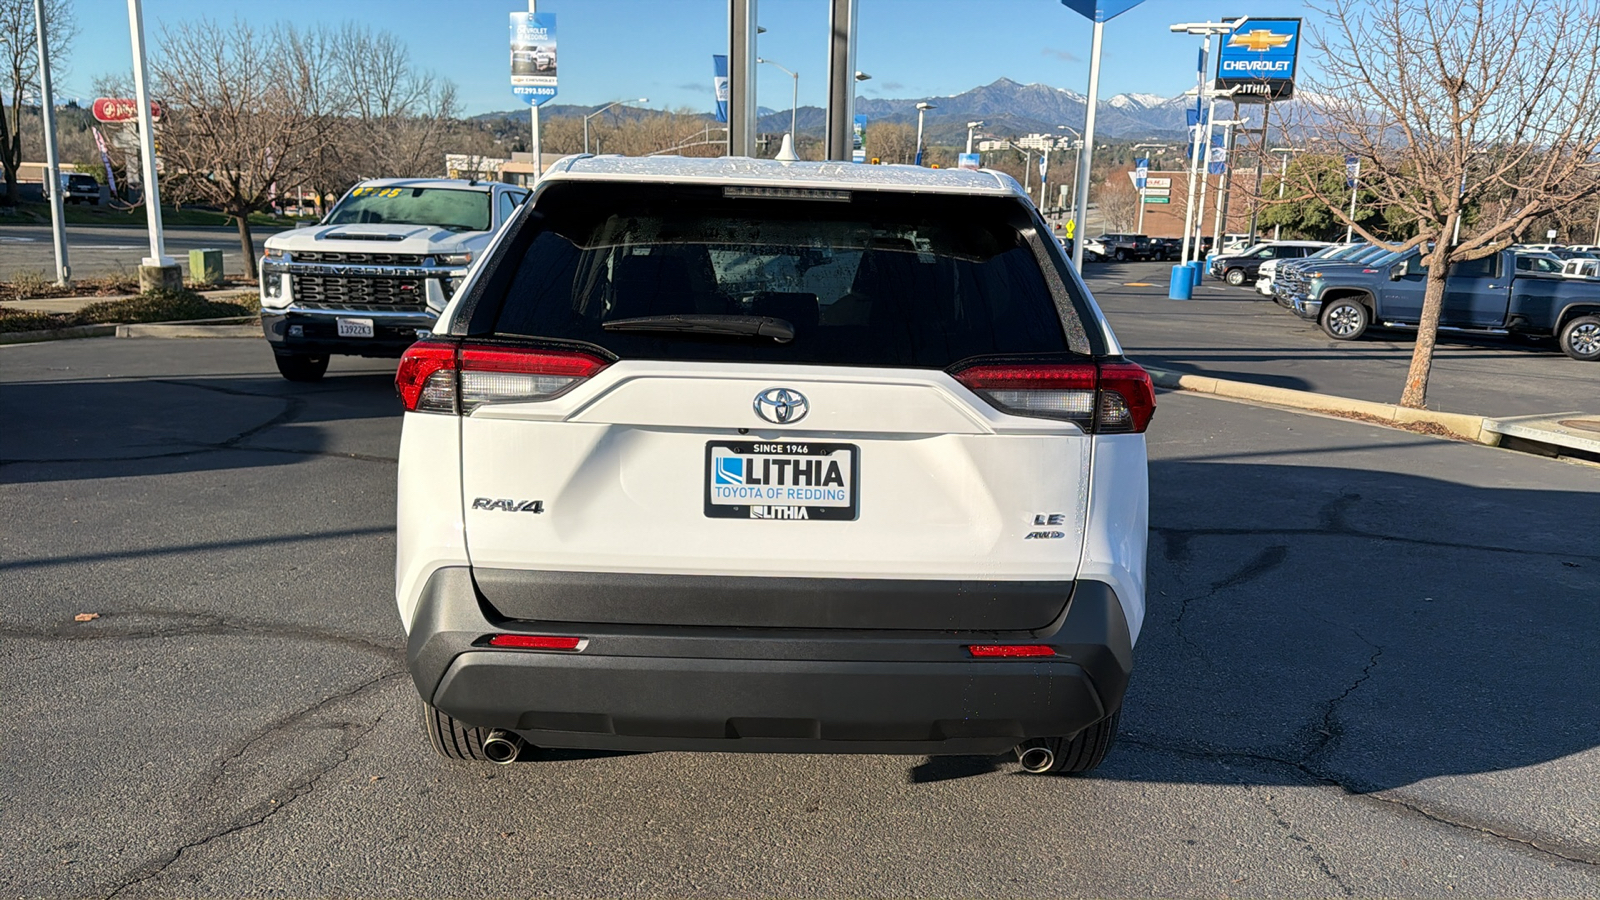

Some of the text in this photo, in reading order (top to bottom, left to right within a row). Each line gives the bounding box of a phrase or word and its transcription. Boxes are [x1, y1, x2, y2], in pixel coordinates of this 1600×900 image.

[1223, 60, 1291, 71] CHEVROLET
[513, 87, 555, 96] 877.293.5503
[340, 325, 372, 335] 13922K3
[753, 444, 809, 454] SINCE 1946
[745, 458, 844, 487] LITHIA
[715, 486, 845, 501] TOYOTA OF REDDING
[472, 497, 544, 514] RAV4
[763, 505, 809, 520] LITHIA
[1033, 514, 1066, 525] LE
[1024, 531, 1065, 540] AWD
